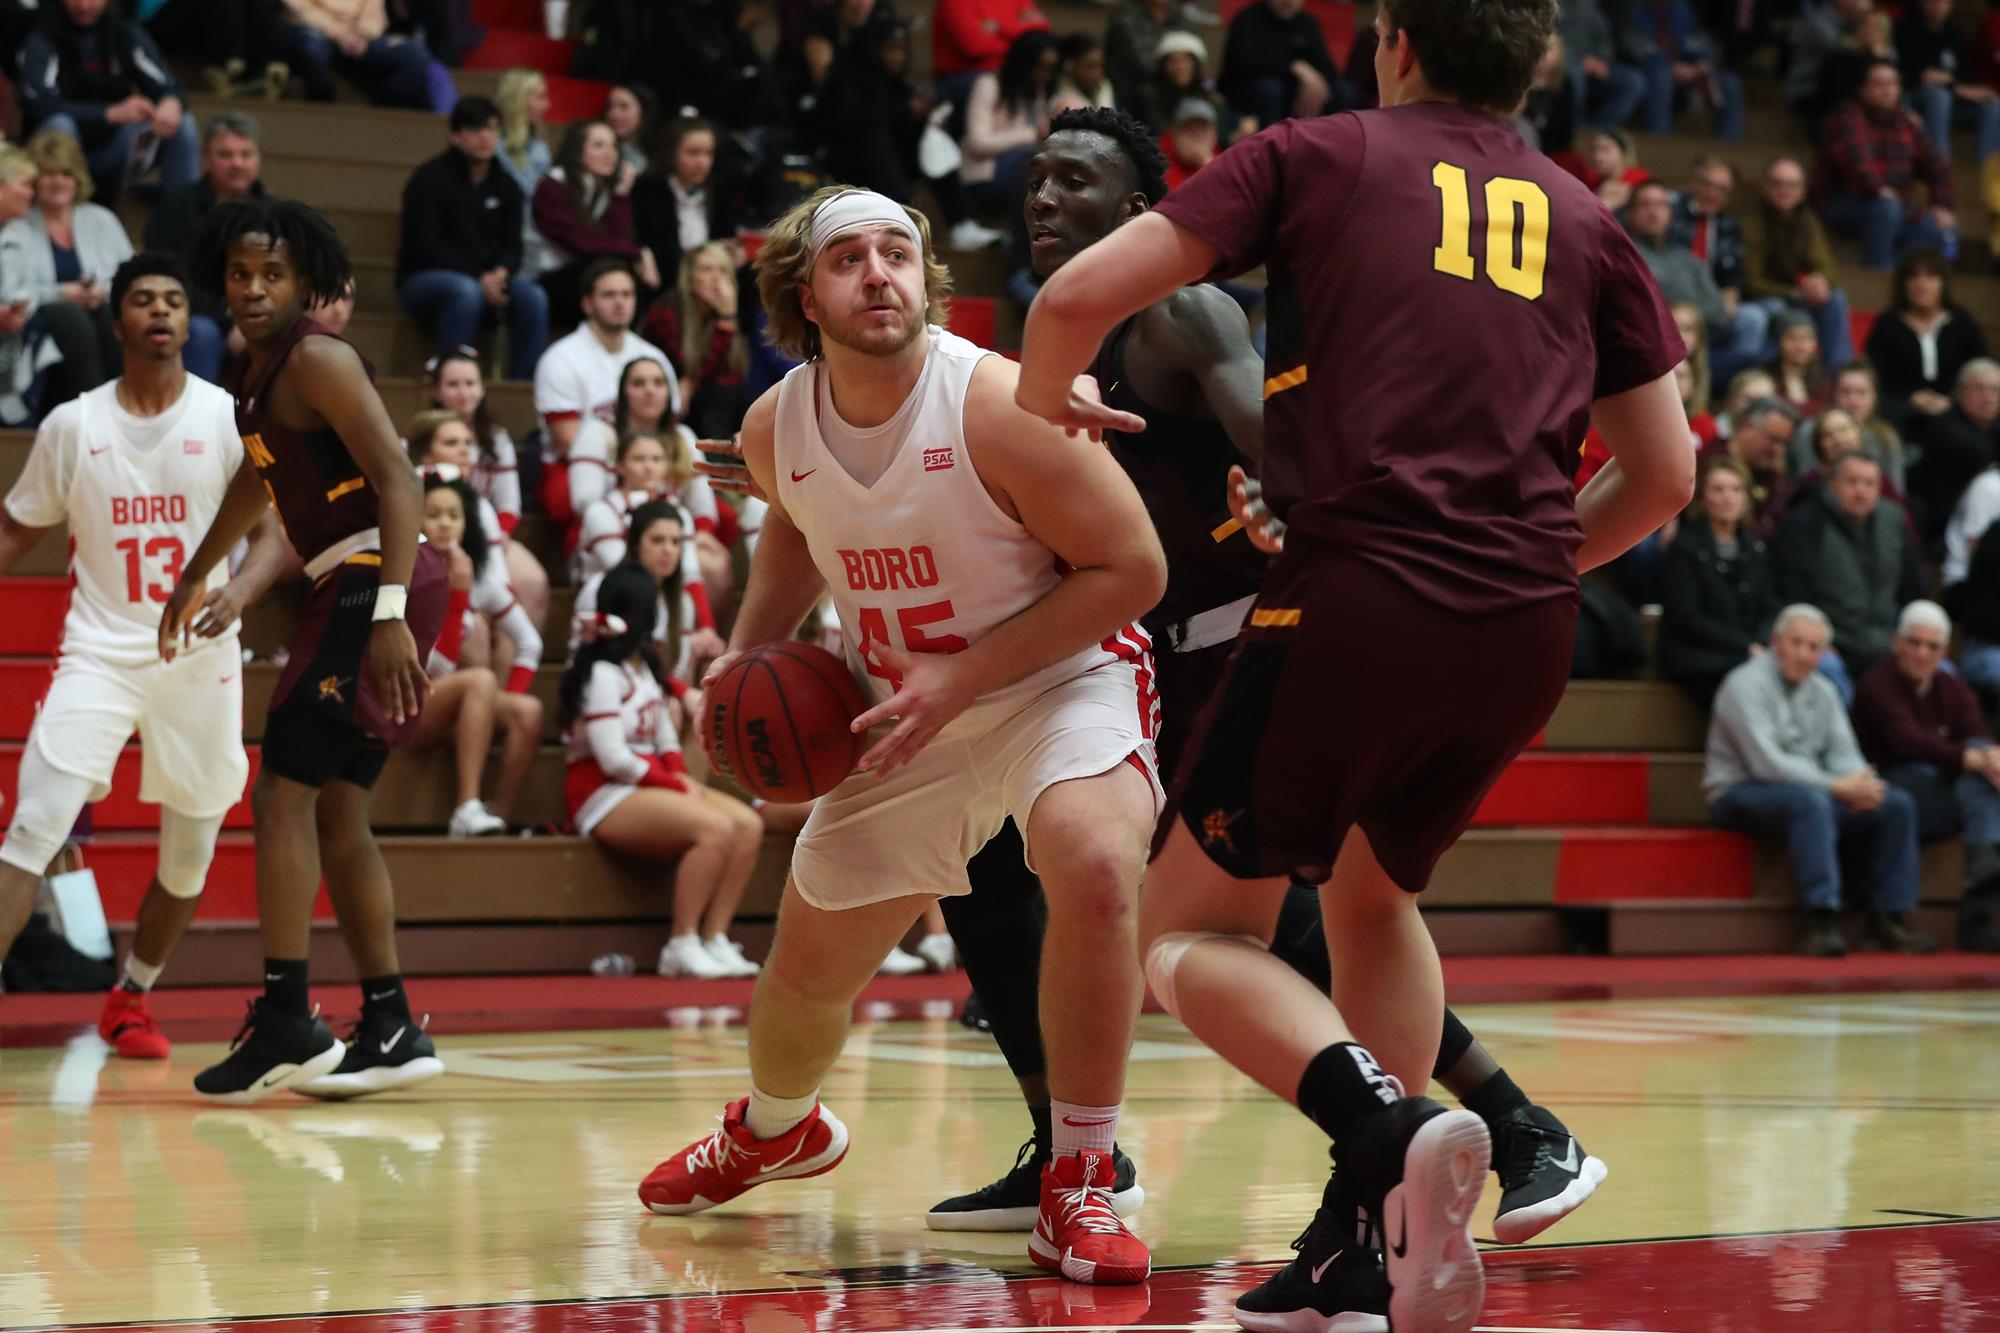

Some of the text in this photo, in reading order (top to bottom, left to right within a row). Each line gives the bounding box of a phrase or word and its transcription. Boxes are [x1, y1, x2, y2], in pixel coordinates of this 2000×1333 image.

[1431, 160, 1550, 301] 10
[923, 452, 954, 466] PSAC
[112, 494, 186, 525] BORO
[115, 536, 185, 603] 13
[837, 545, 939, 591] BORO
